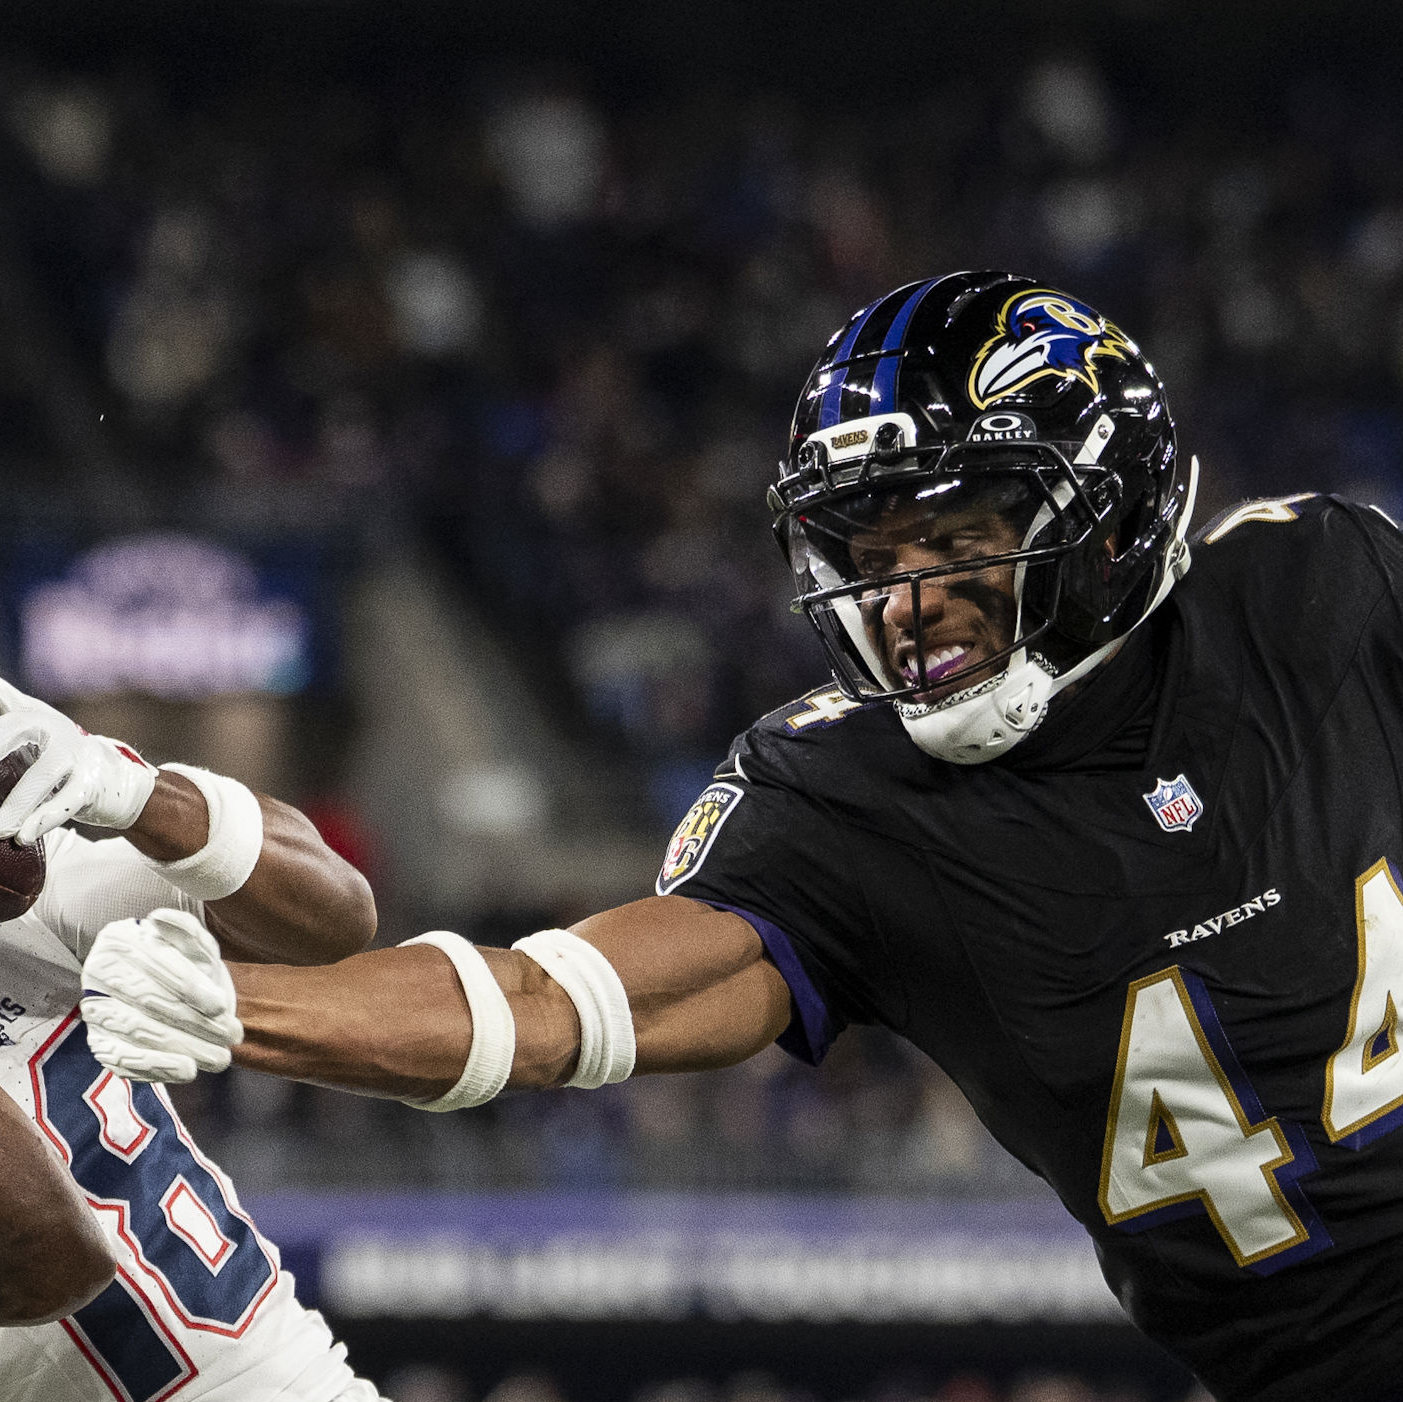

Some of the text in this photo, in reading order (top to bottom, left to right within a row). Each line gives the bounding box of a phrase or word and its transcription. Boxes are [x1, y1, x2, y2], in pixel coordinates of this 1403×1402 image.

[831, 430, 868, 449] RAVENS
[973, 430, 1033, 442] OAKLEY
[1161, 797, 1194, 825] NFL
[1163, 888, 1282, 948] RAVENS
